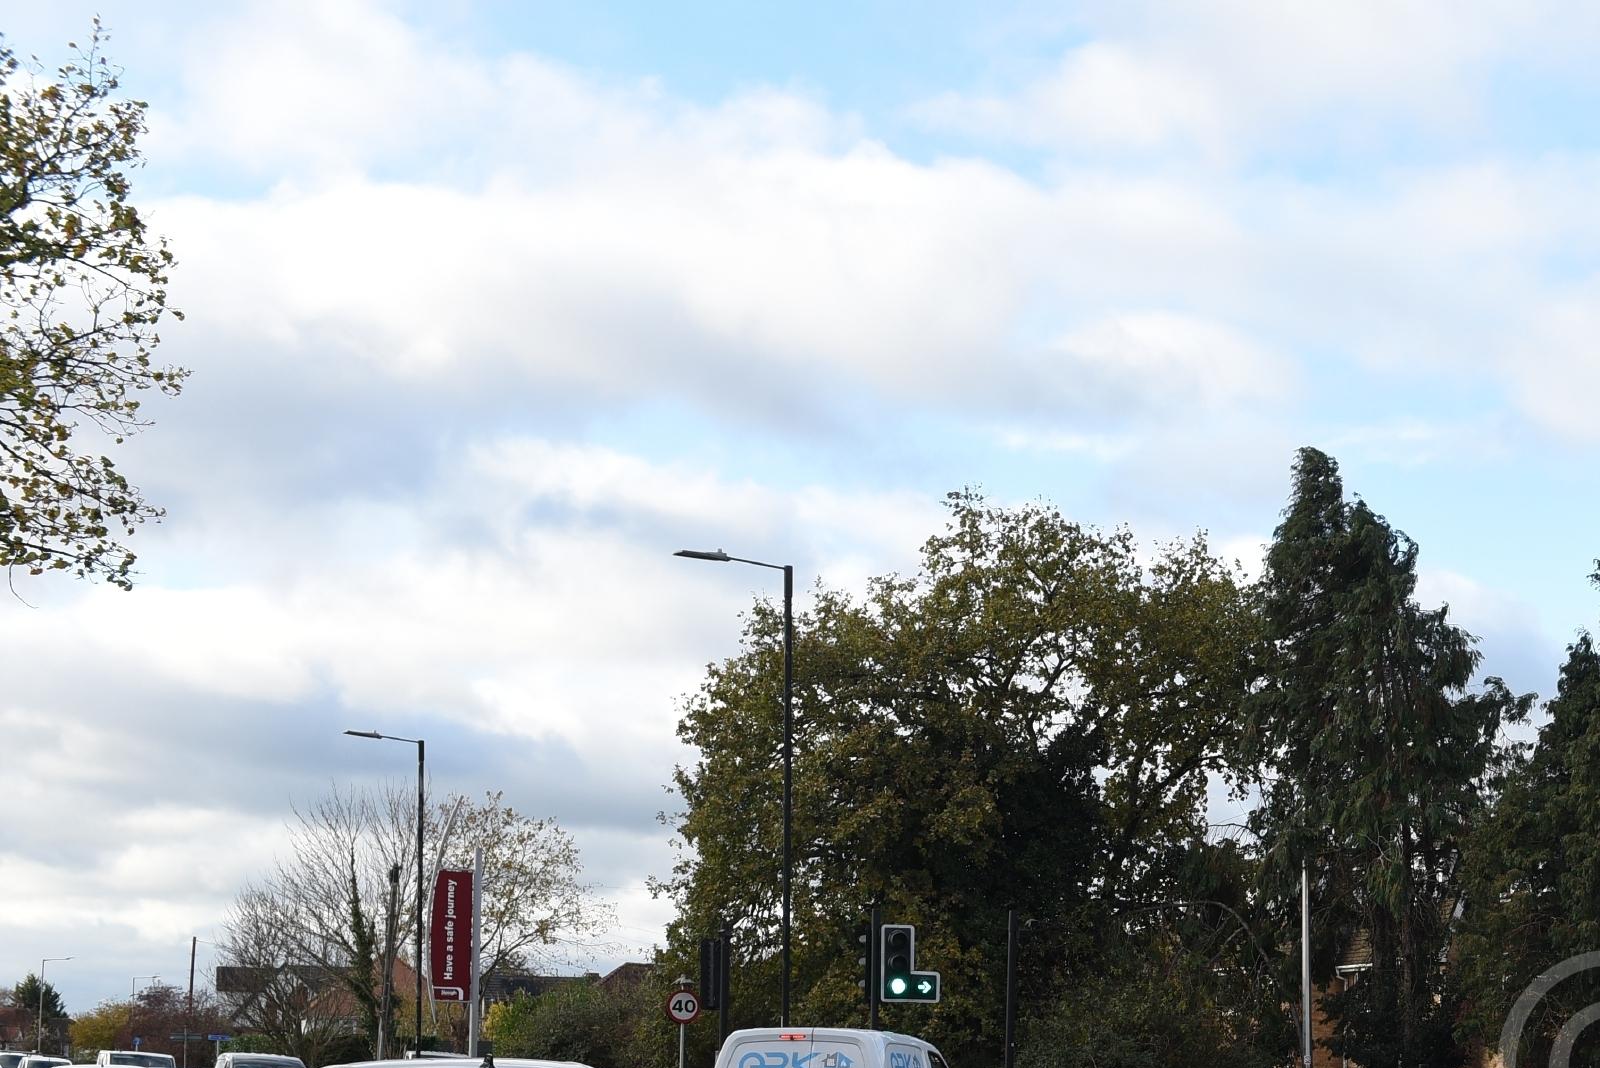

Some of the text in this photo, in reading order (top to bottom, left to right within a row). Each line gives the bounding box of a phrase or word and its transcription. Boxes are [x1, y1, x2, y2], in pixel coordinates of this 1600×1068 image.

[445, 879, 457, 919] journey
[444, 921, 454, 940] safe
[443, 955, 453, 980] Have
[672, 1000, 696, 1013] 40
